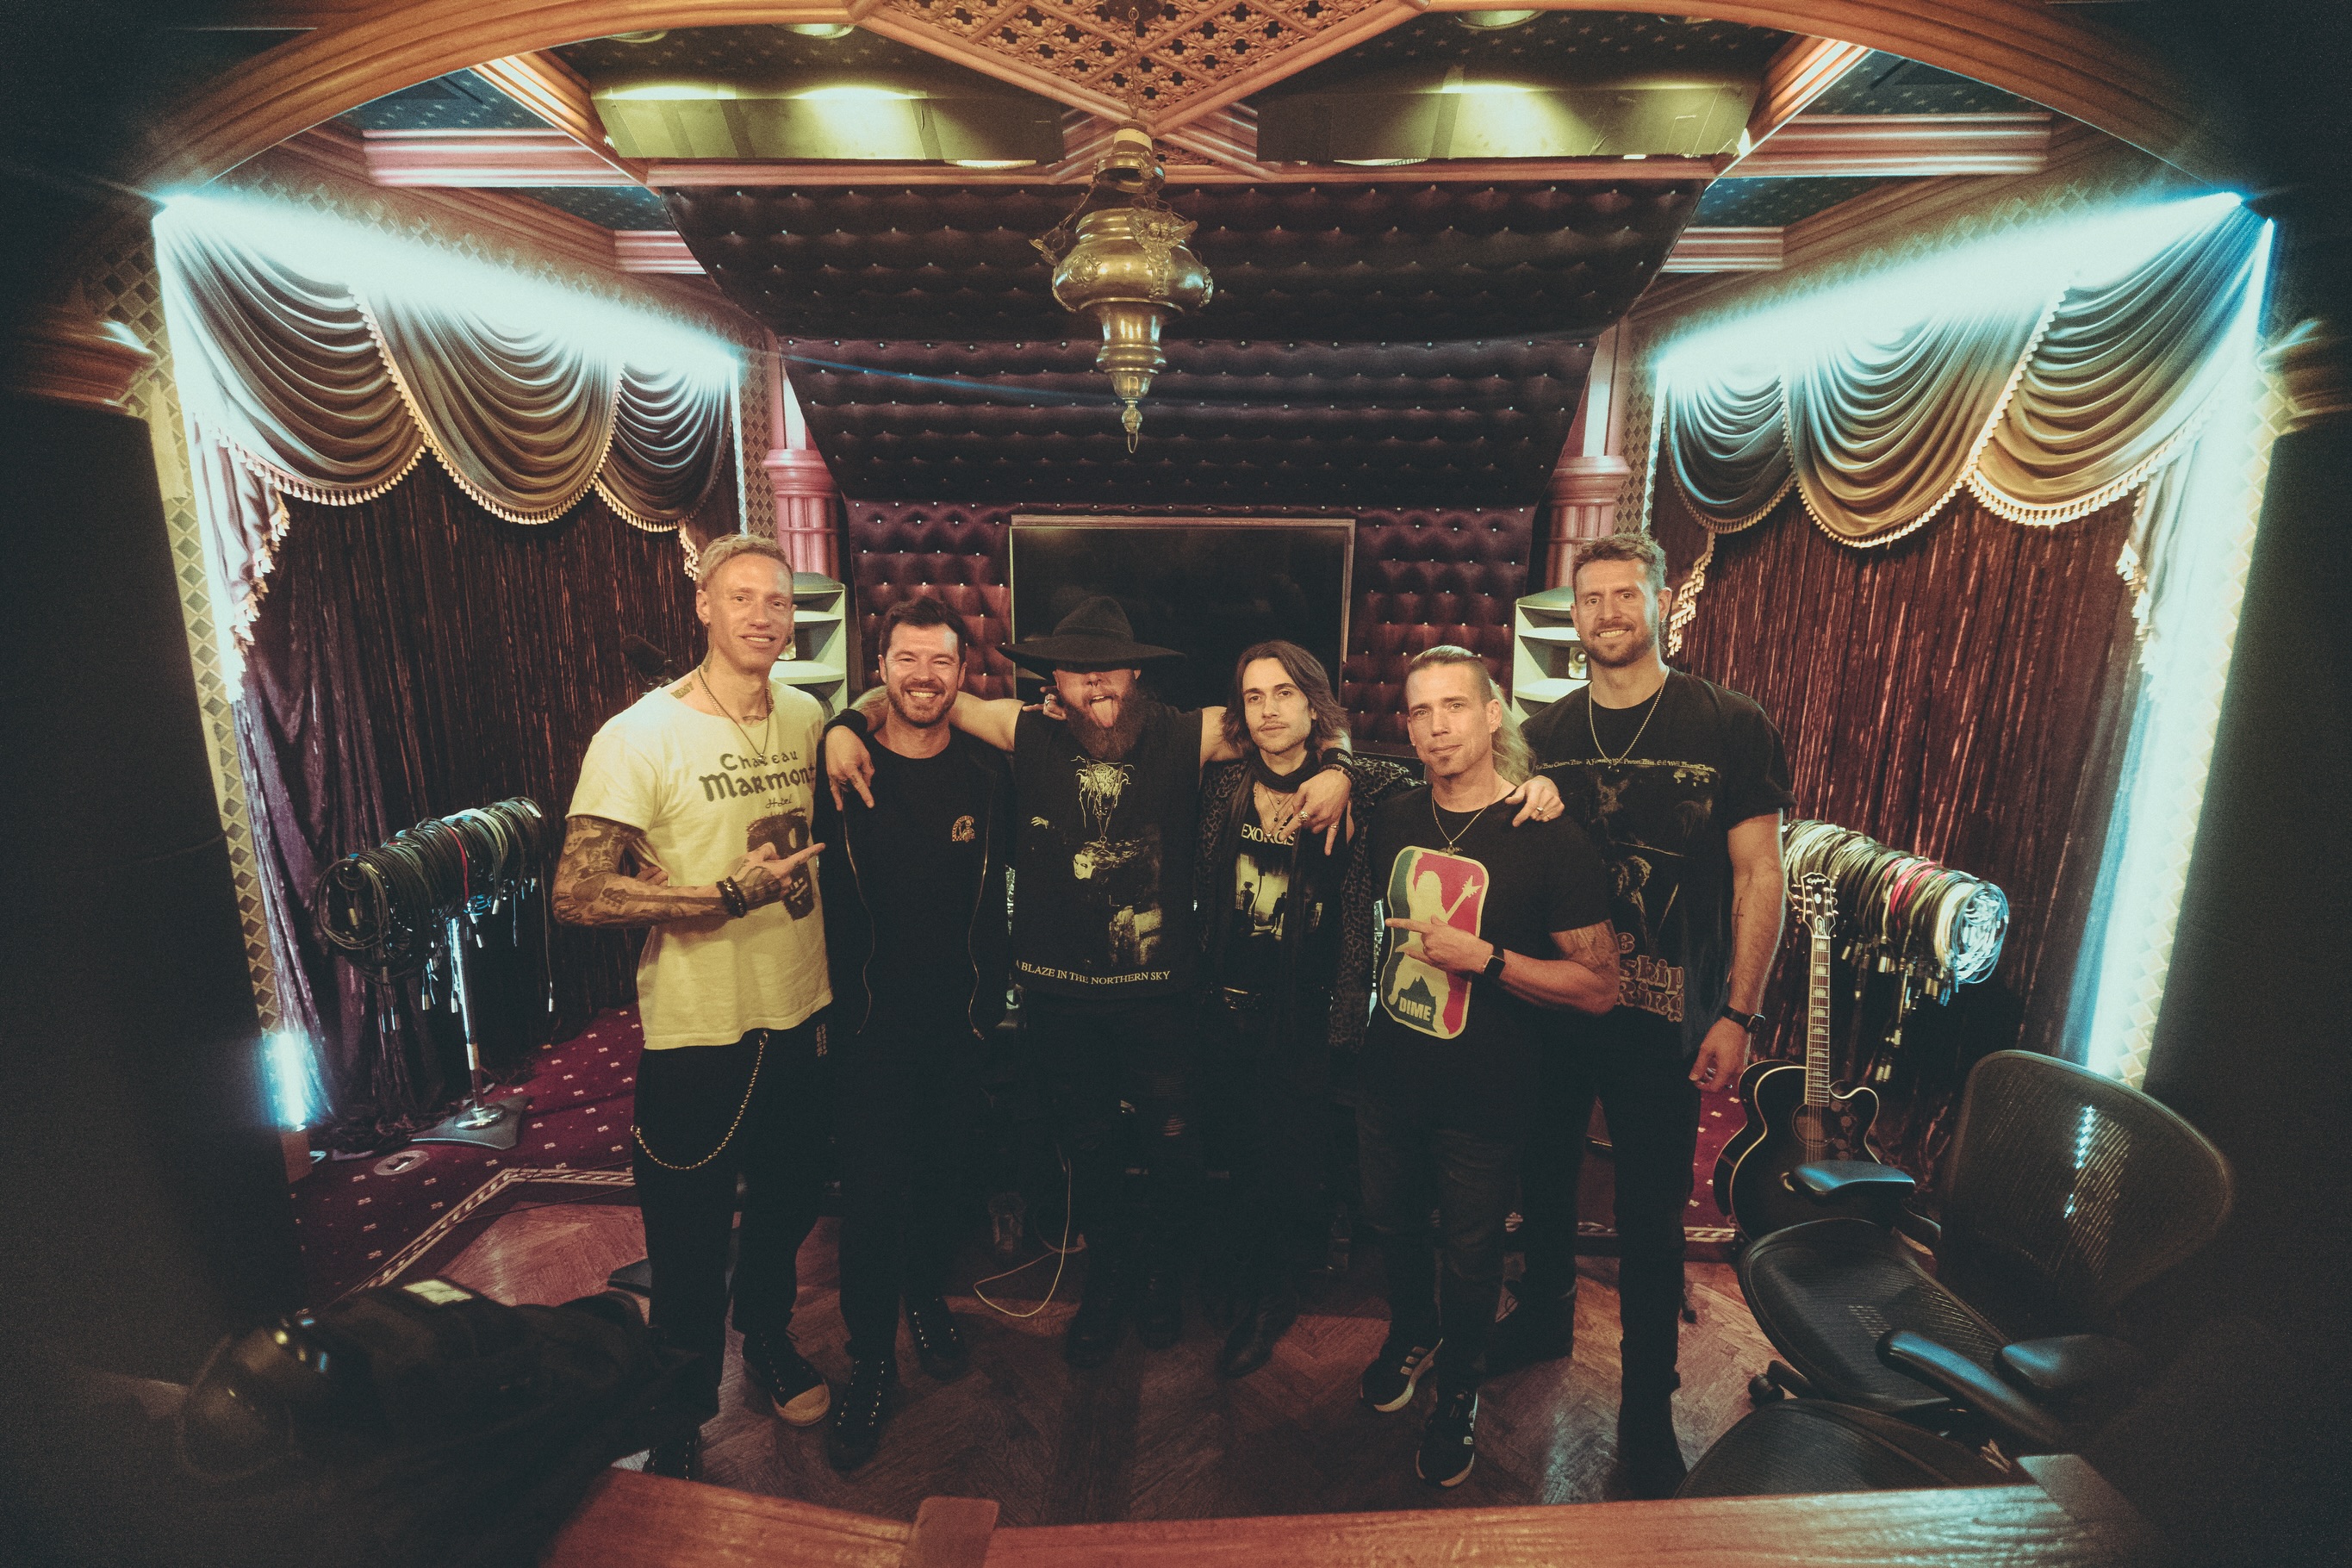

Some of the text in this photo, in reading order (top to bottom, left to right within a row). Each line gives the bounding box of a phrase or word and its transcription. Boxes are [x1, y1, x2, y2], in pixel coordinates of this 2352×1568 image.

[1021, 961, 1055, 978] BLAZE
[1056, 969, 1068, 980] IN
[1069, 971, 1089, 984] THE
[1091, 971, 1149, 985] NORTHERN
[1150, 970, 1171, 980] SKY
[1398, 996, 1432, 1022] DIME
